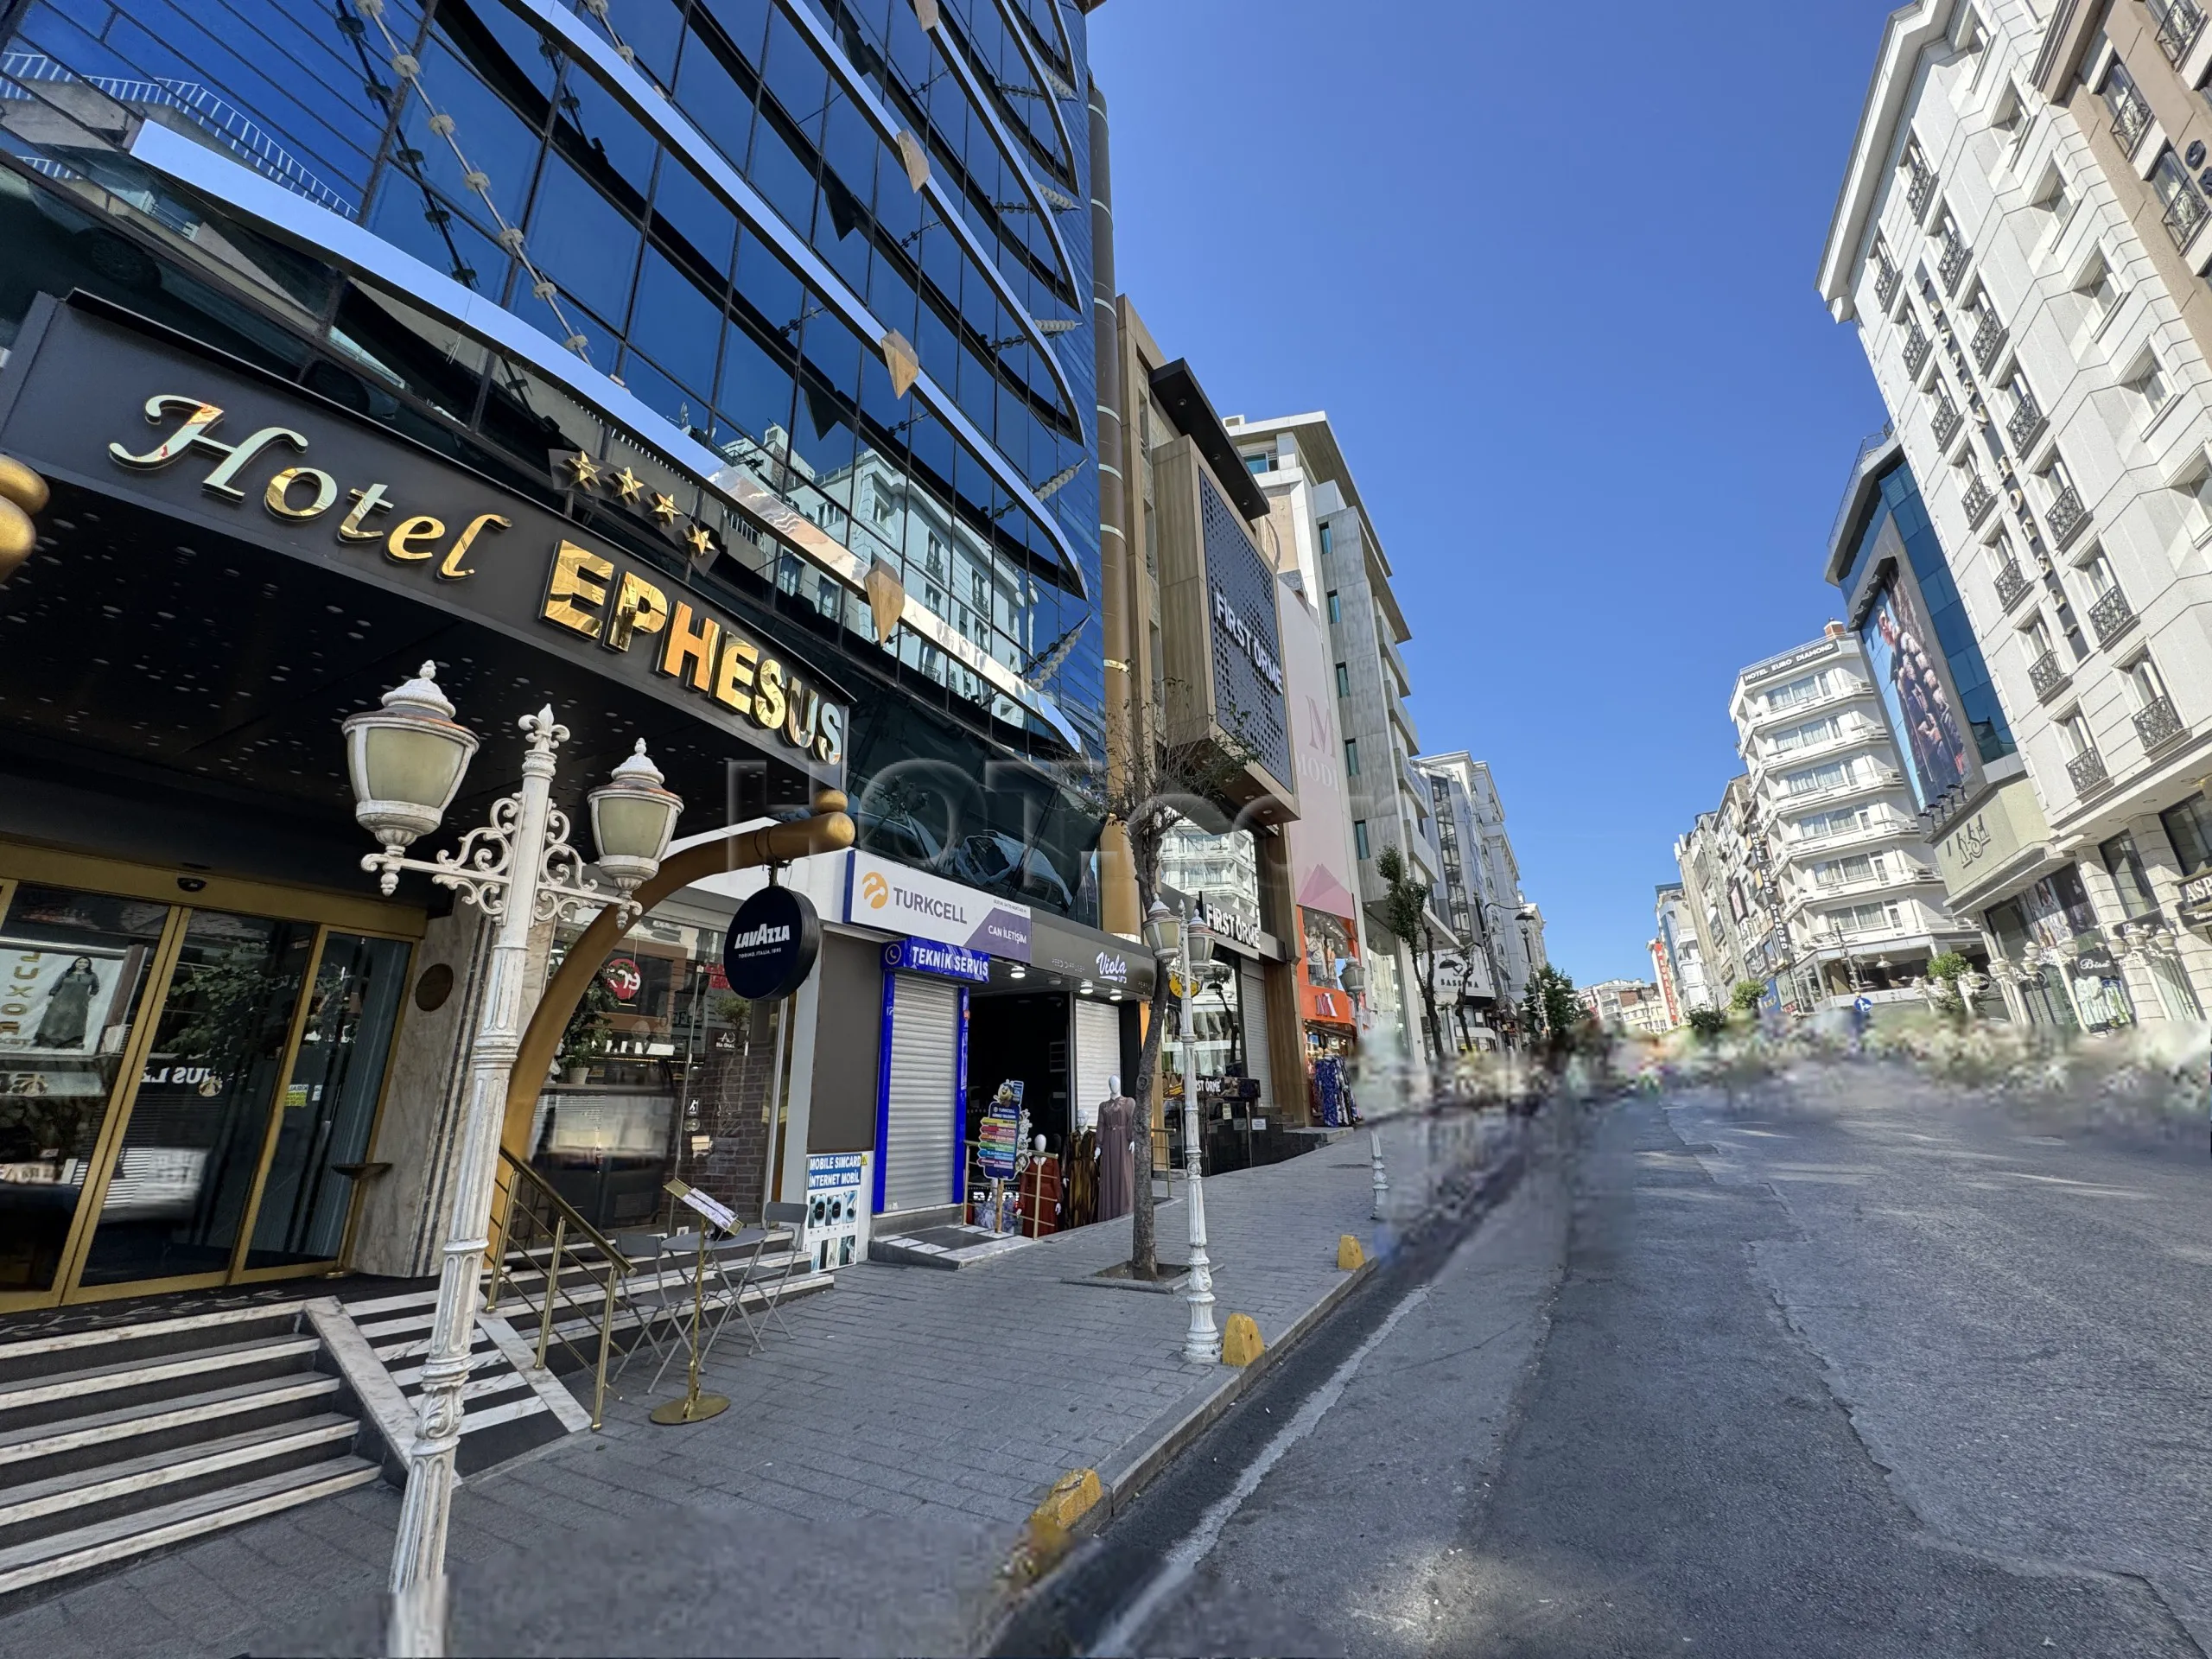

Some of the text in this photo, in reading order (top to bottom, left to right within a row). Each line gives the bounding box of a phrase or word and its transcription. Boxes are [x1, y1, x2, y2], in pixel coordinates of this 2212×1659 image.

[109, 394, 843, 766] Hotel EPHESUS
[1745, 643, 1834, 682] HOTEL EURO DIAMOND
[1751, 832, 1788, 950] HOTEL EURO DIAMOND
[893, 887, 967, 925] TURKCELL
[734, 923, 791, 950] LAVAZZA
[988, 925, 1002, 938] CAN
[912, 945, 989, 977] TEKNİK SERVİS
[1096, 951, 1127, 976] Viola
[1440, 978, 1479, 988] SASSNA
[810, 1155, 861, 1171] MOBILE SIMCARD
